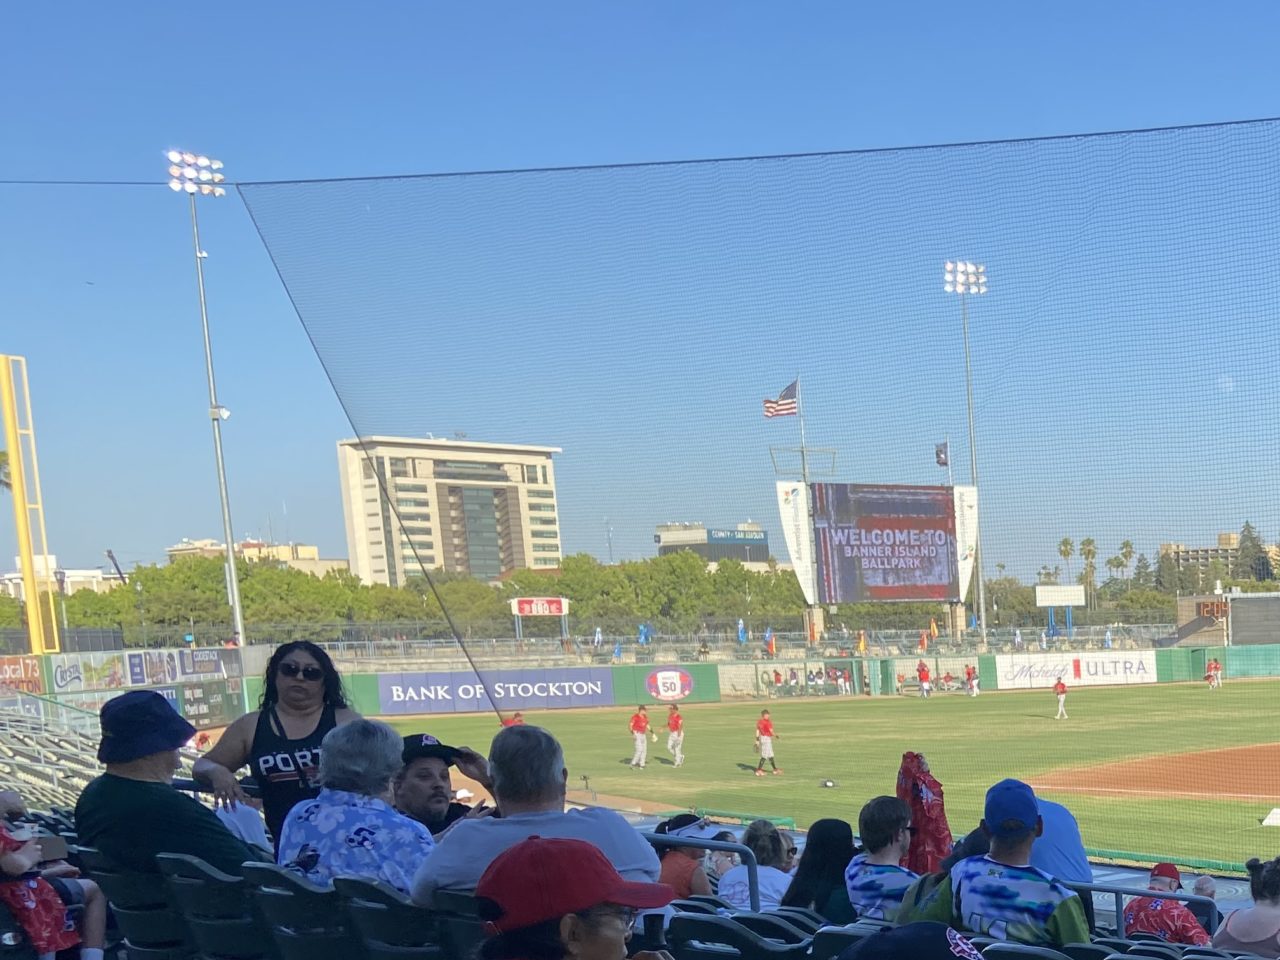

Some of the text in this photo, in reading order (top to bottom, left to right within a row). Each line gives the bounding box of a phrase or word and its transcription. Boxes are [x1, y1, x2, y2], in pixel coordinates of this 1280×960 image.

[831, 529, 945, 545] WELCOME TO
[844, 546, 936, 557] BANNER ISLAND
[861, 558, 921, 569] BALLPARK
[25, 660, 39, 677] 73
[1005, 660, 1147, 680] Michelob ULTRA
[391, 681, 602, 701] BANK OF STOCKTON
[662, 682, 676, 692] 50
